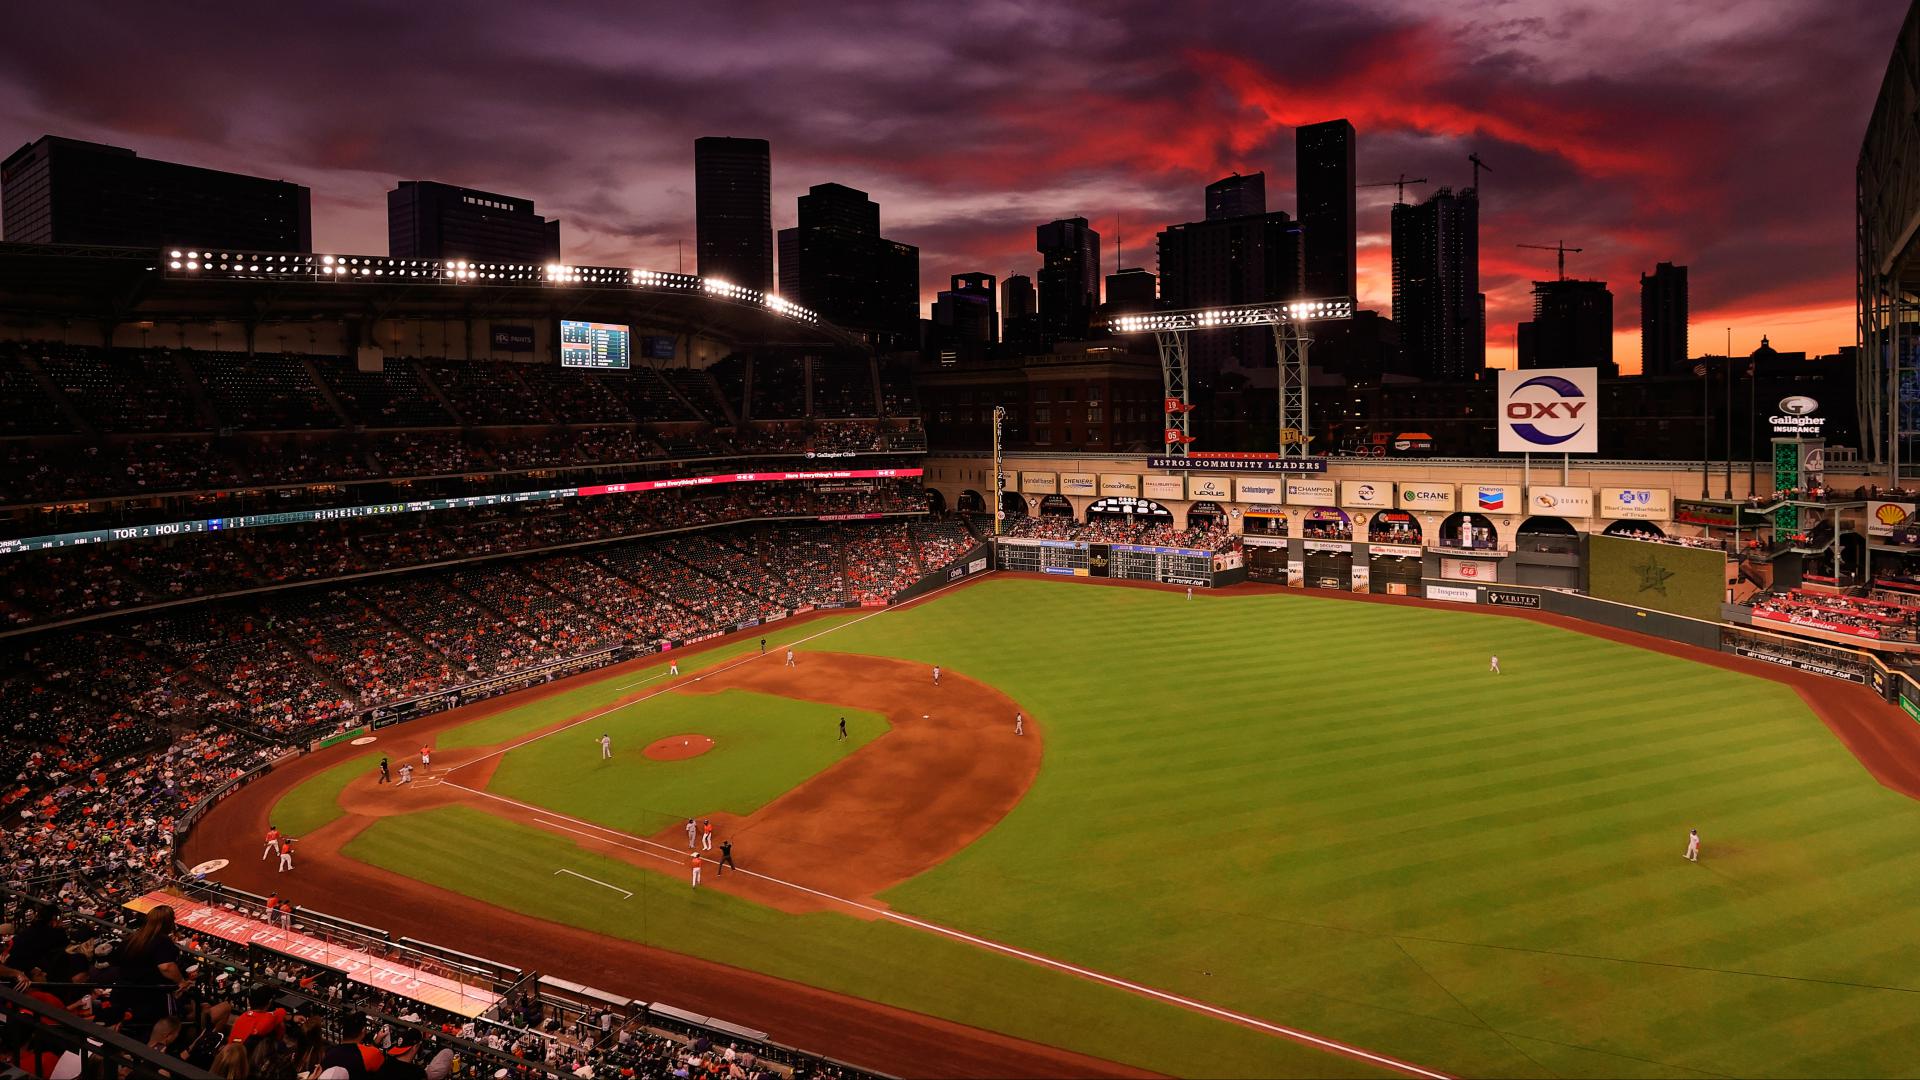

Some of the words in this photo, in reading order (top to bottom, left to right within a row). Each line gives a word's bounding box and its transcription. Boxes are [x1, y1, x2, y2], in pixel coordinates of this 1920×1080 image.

[1507, 402, 1587, 419] OXY
[1768, 415, 1826, 426] Gallagher
[1284, 432, 1294, 440] 17
[1195, 460, 1263, 469] COMMUNITY
[1268, 461, 1320, 470] LEADERS
[668, 479, 698, 487] Everything's
[1102, 482, 1137, 490] ConocoPhillips
[1241, 485, 1276, 495] Schlumberger
[1416, 491, 1449, 500] CRANE
[113, 528, 138, 539] TOR
[155, 524, 179, 535] HOU
[184, 524, 191, 532] 3
[1462, 567, 1475, 575] 66
[1437, 586, 1470, 598] Insperity
[1499, 594, 1538, 604] VERITEX
[1788, 613, 1838, 631] Budweiser
[250, 929, 287, 944] OF
[284, 940, 328, 960] THE
[331, 955, 422, 990] ASTROS
